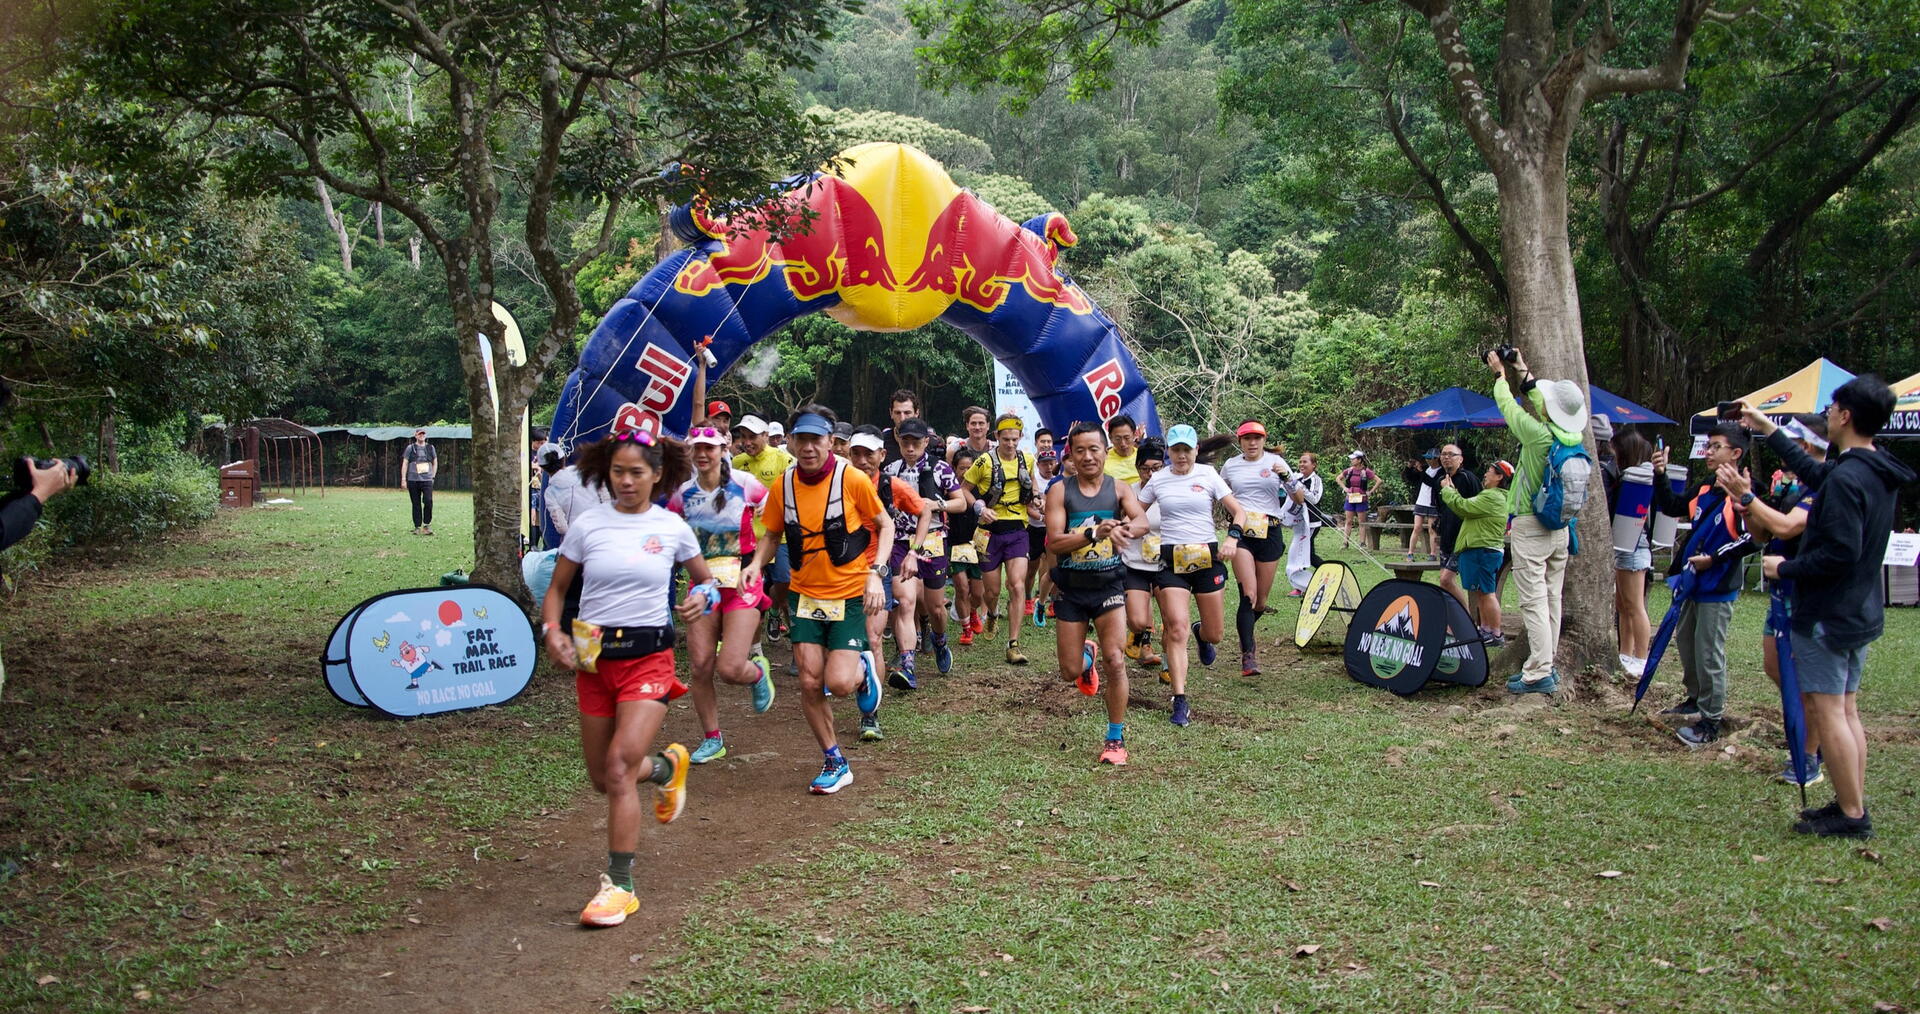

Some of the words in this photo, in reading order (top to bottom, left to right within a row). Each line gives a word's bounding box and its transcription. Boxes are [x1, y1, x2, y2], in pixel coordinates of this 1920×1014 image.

[612, 343, 691, 436] Bull
[1083, 358, 1125, 436] Re
[1905, 411, 1920, 430] GO
[466, 628, 494, 644] FAT
[465, 642, 500, 659] MAK
[1357, 632, 1372, 653] NO
[1369, 635, 1393, 659] RACE
[1389, 640, 1404, 662] NO
[1402, 643, 1424, 667] GOAL
[453, 659, 486, 675] TRAIL
[488, 654, 517, 670] RACE
[416, 689, 431, 706] NO
[431, 686, 456, 704] RACE
[456, 683, 471, 700] NO
[472, 680, 497, 697] GOAL
